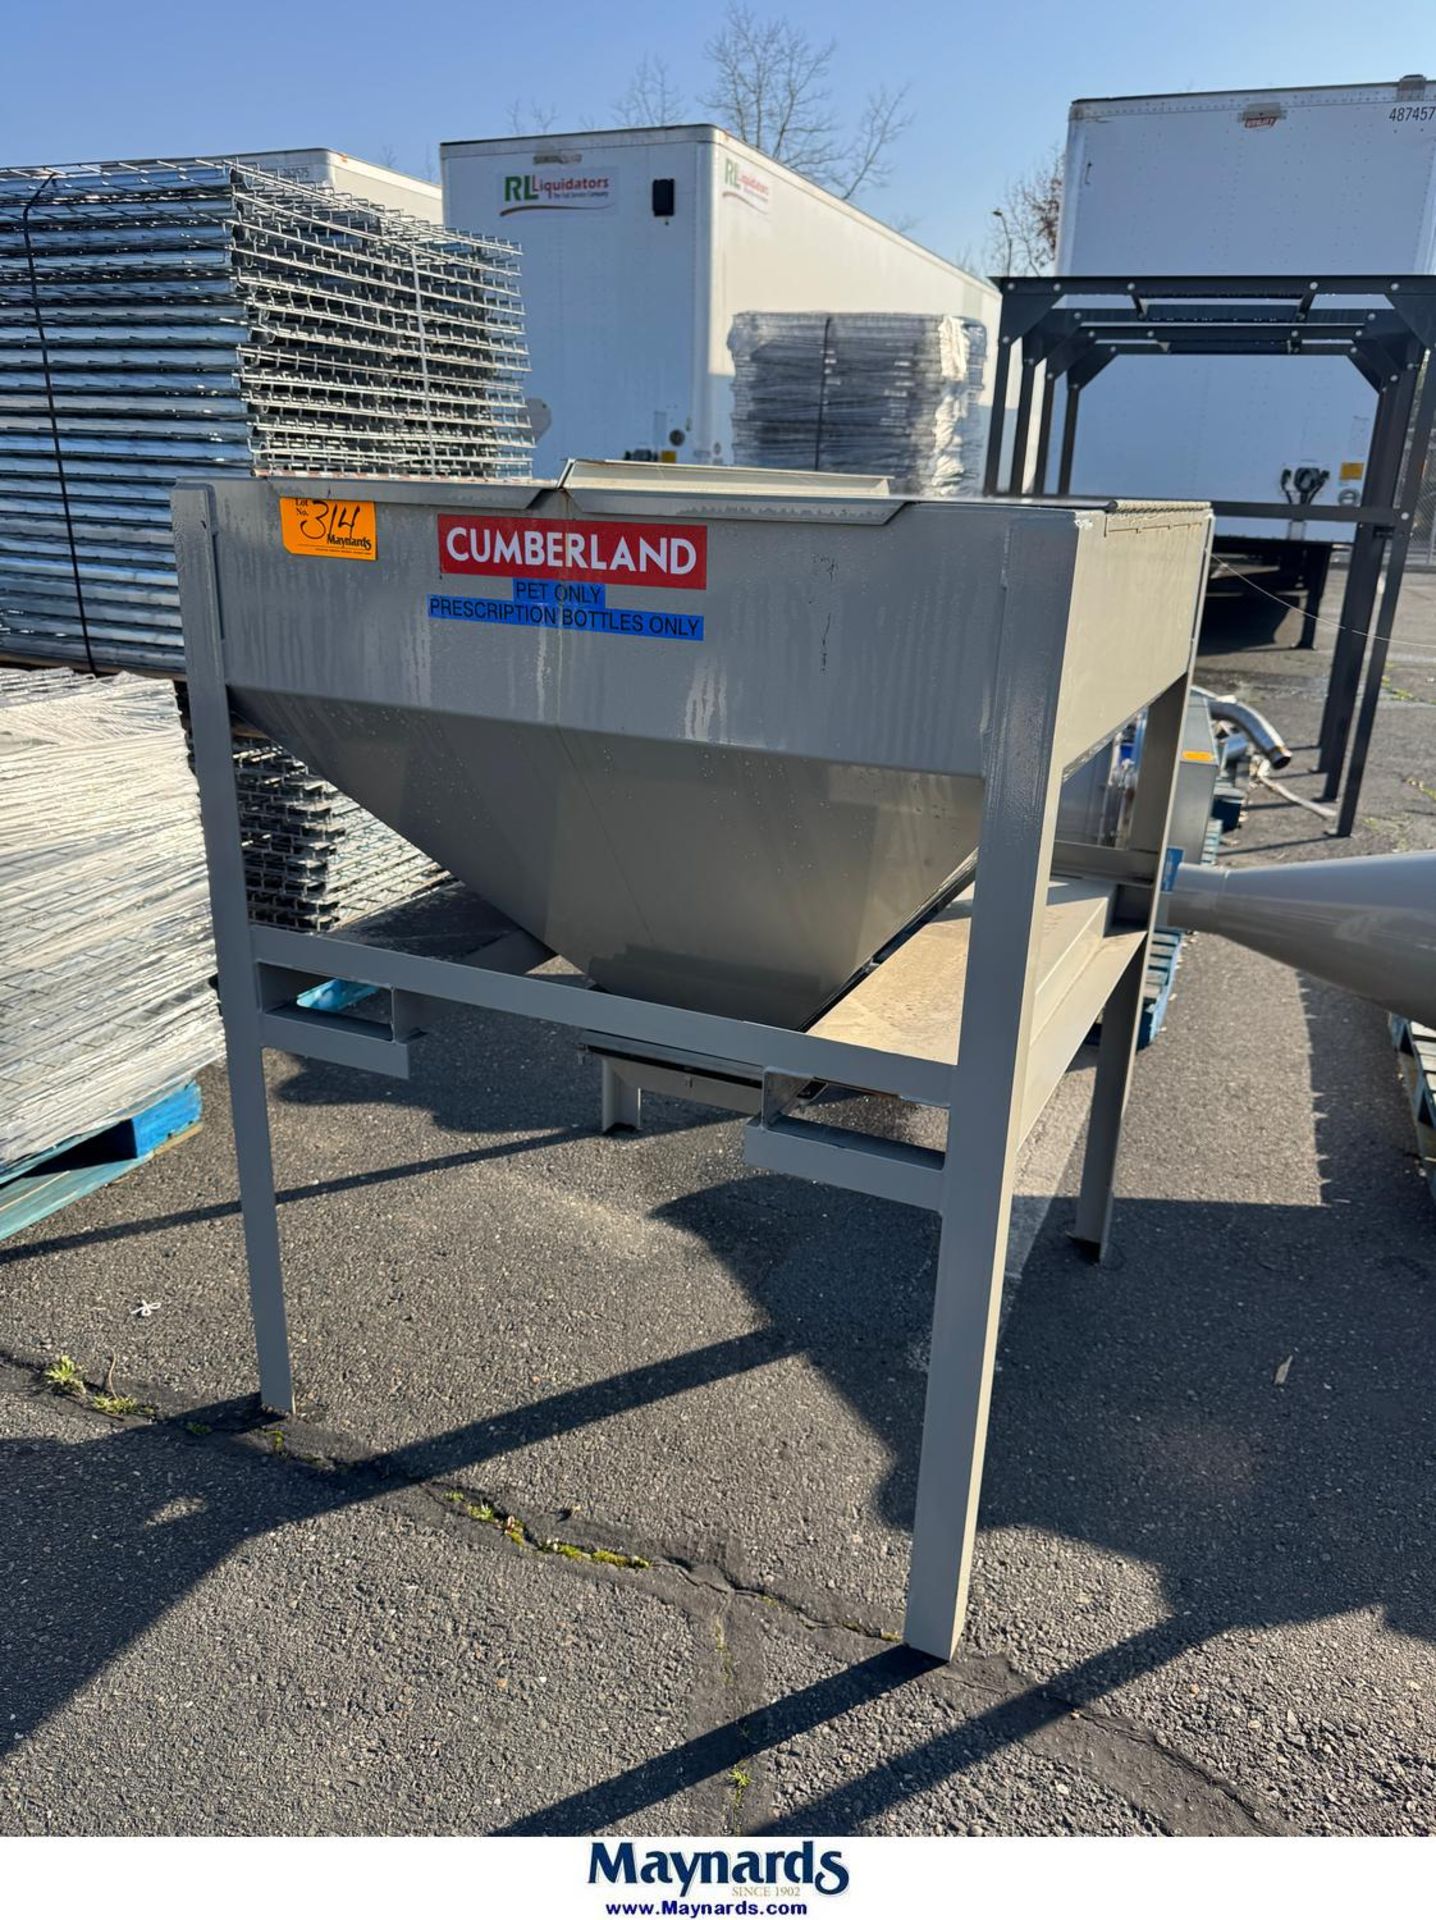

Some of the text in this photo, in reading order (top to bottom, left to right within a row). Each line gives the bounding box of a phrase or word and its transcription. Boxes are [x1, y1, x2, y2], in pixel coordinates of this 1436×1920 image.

[1389, 106, 1436, 121] 487457
[504, 175, 609, 201] RL Liquidators
[300, 500, 361, 540] 314
[446, 527, 697, 576] CUMBERLAND
[516, 582, 602, 605] PET ONLY
[430, 598, 701, 638] PRESCRIPTION BOTTLES ONLY
